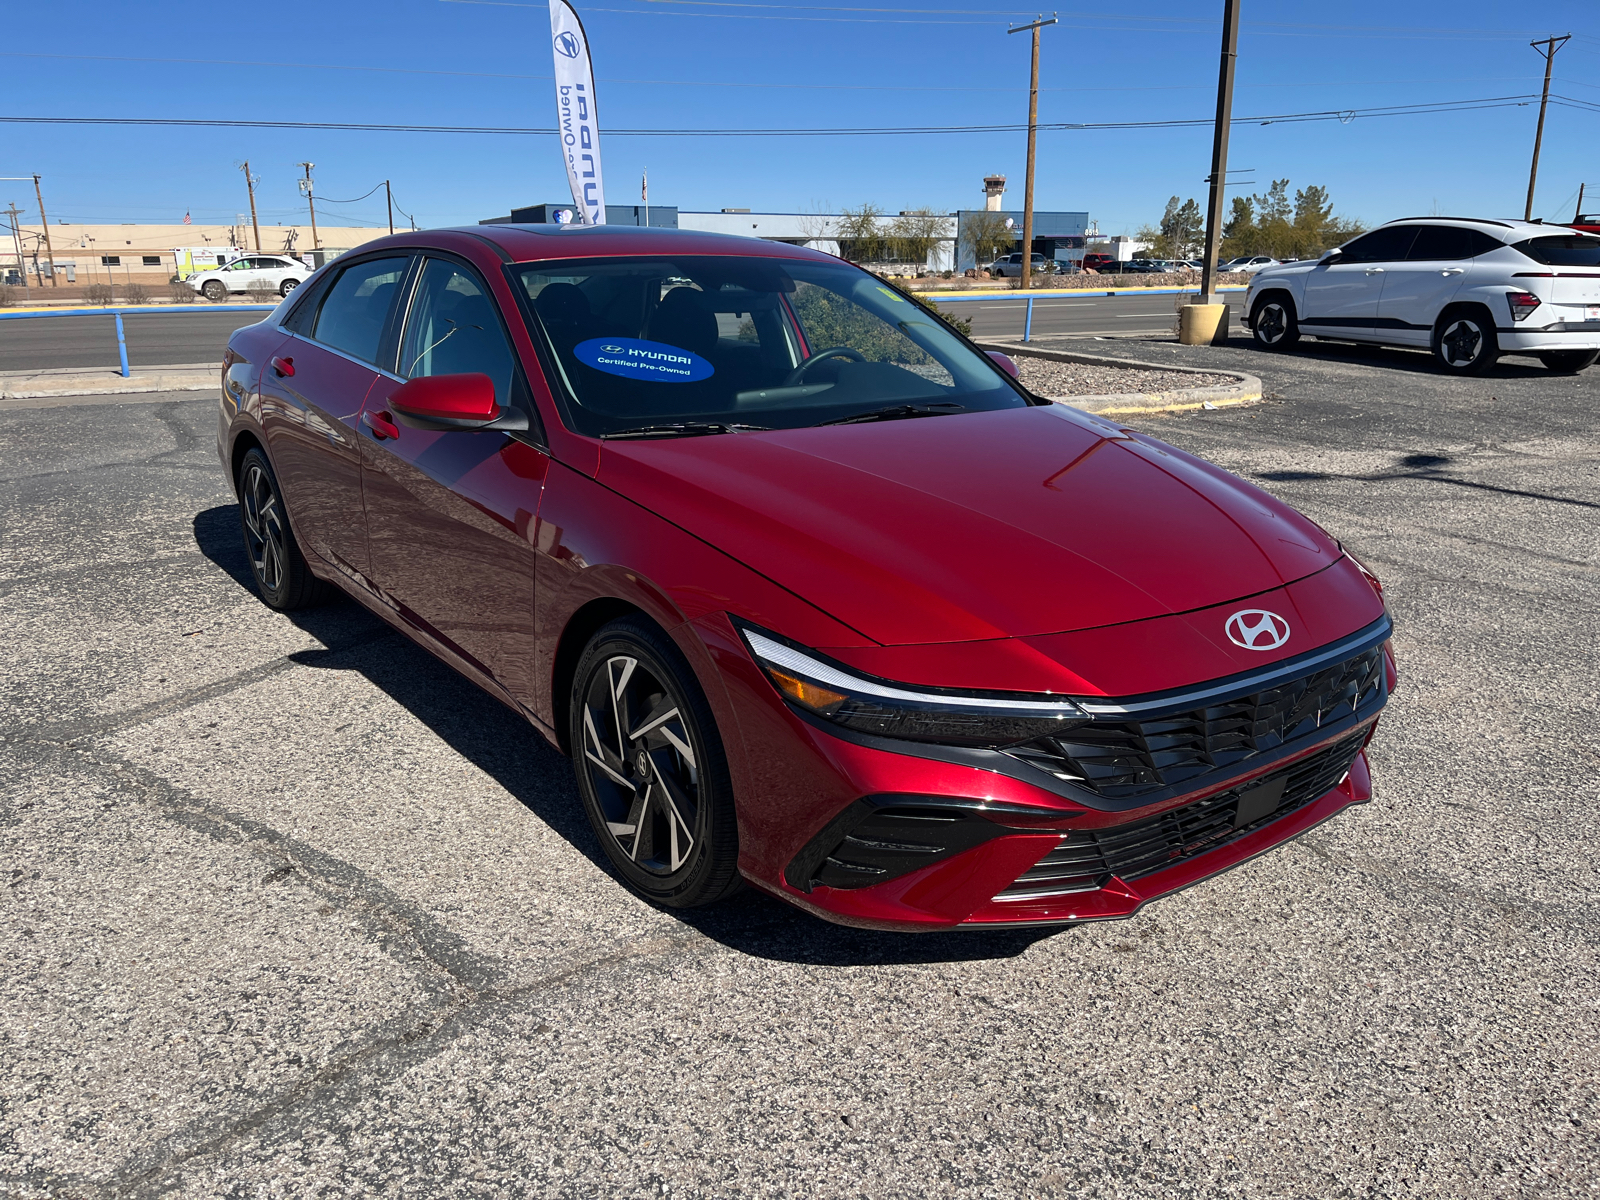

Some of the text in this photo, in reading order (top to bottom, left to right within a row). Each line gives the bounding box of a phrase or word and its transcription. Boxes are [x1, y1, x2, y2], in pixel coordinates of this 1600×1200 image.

[628, 348, 692, 365] HYUNDAI
[597, 357, 691, 376] Certified Pre-Owned
